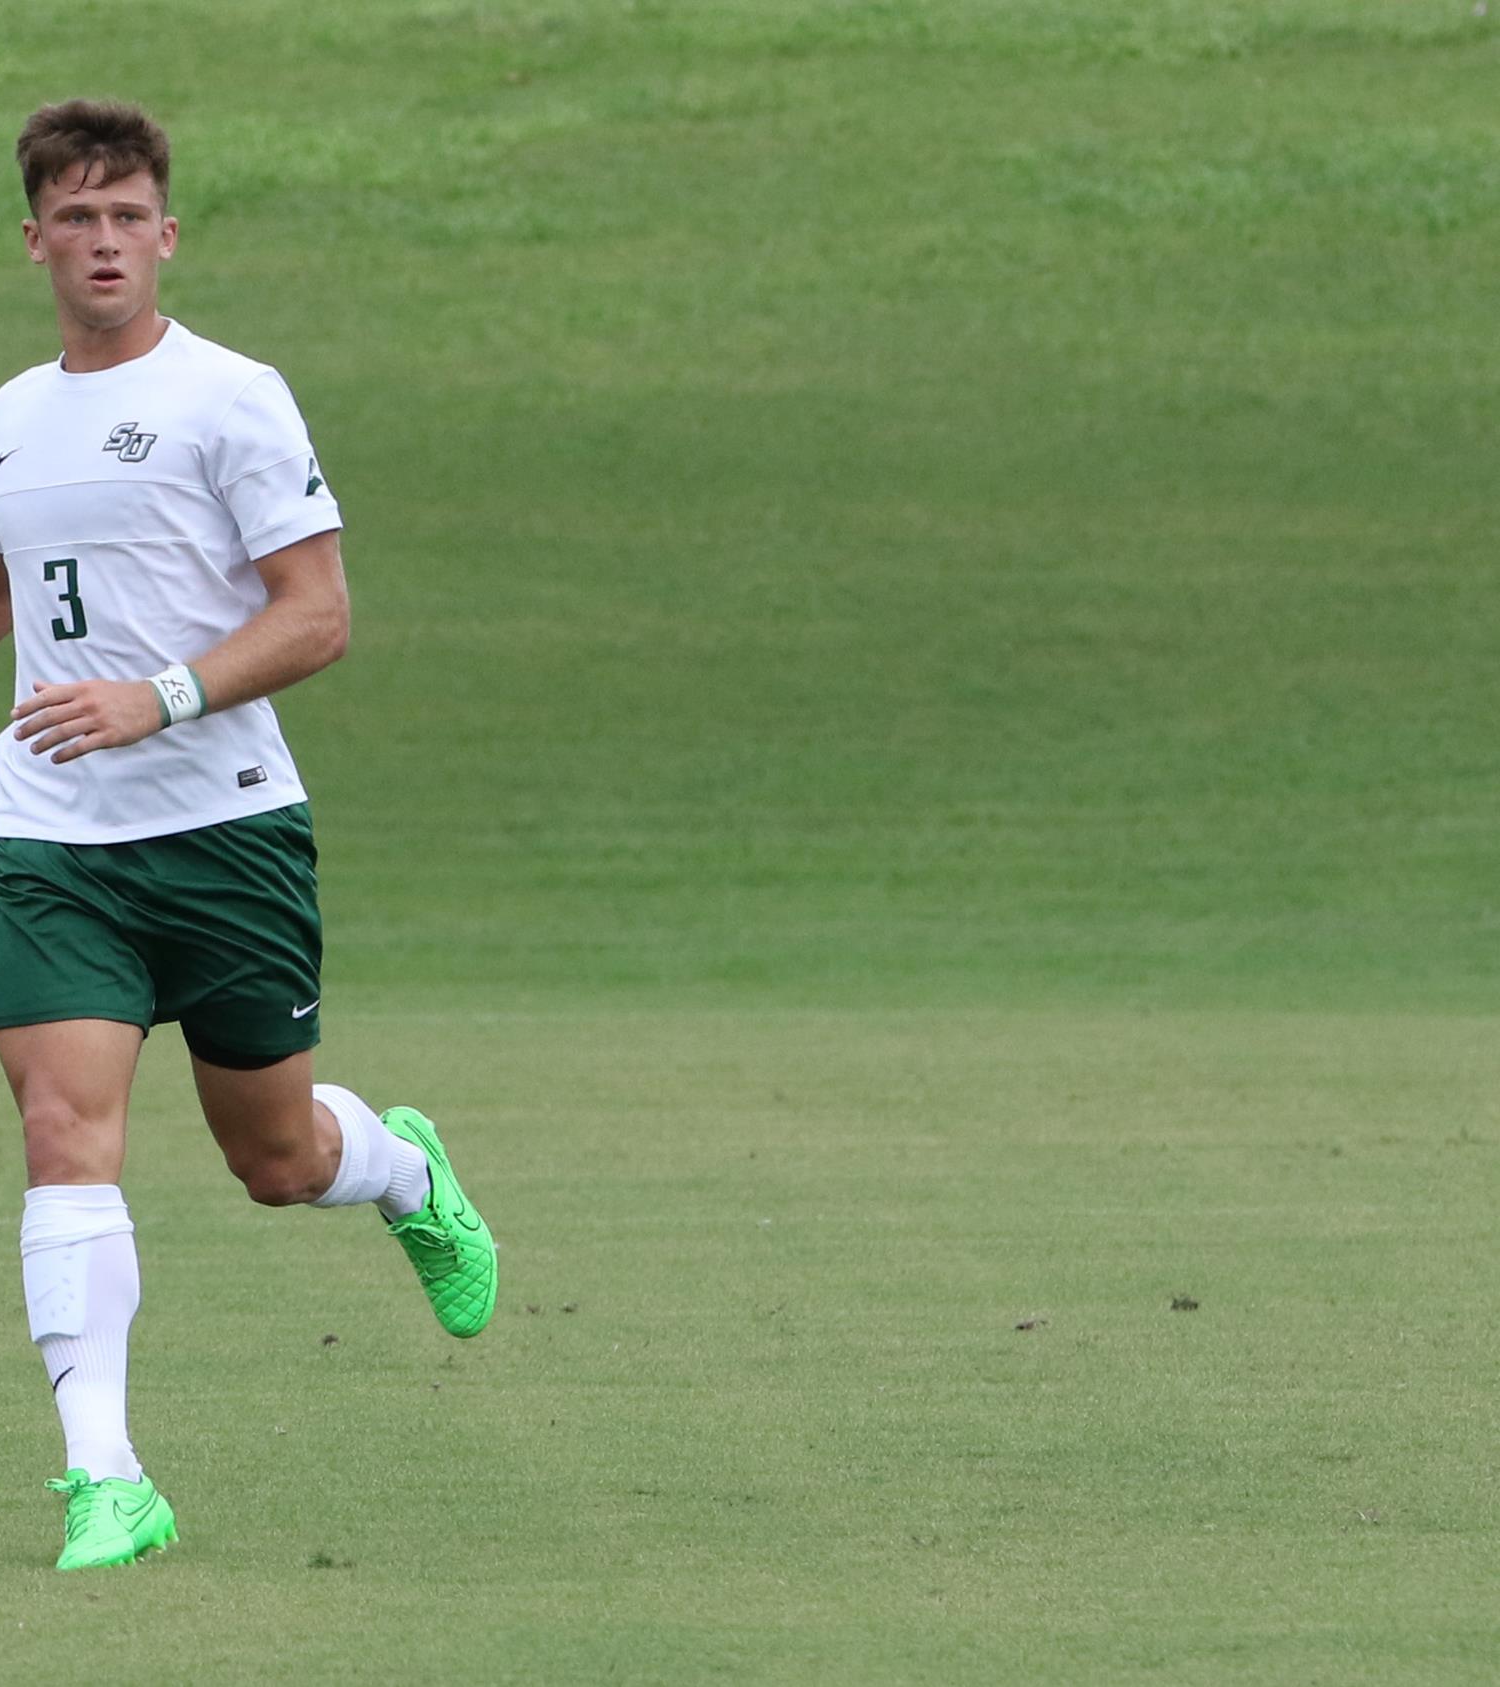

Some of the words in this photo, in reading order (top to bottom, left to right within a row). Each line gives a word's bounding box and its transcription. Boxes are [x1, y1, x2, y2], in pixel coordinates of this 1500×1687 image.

[102, 422, 158, 463] SU
[43, 558, 88, 641] 3
[160, 678, 192, 709] 37
